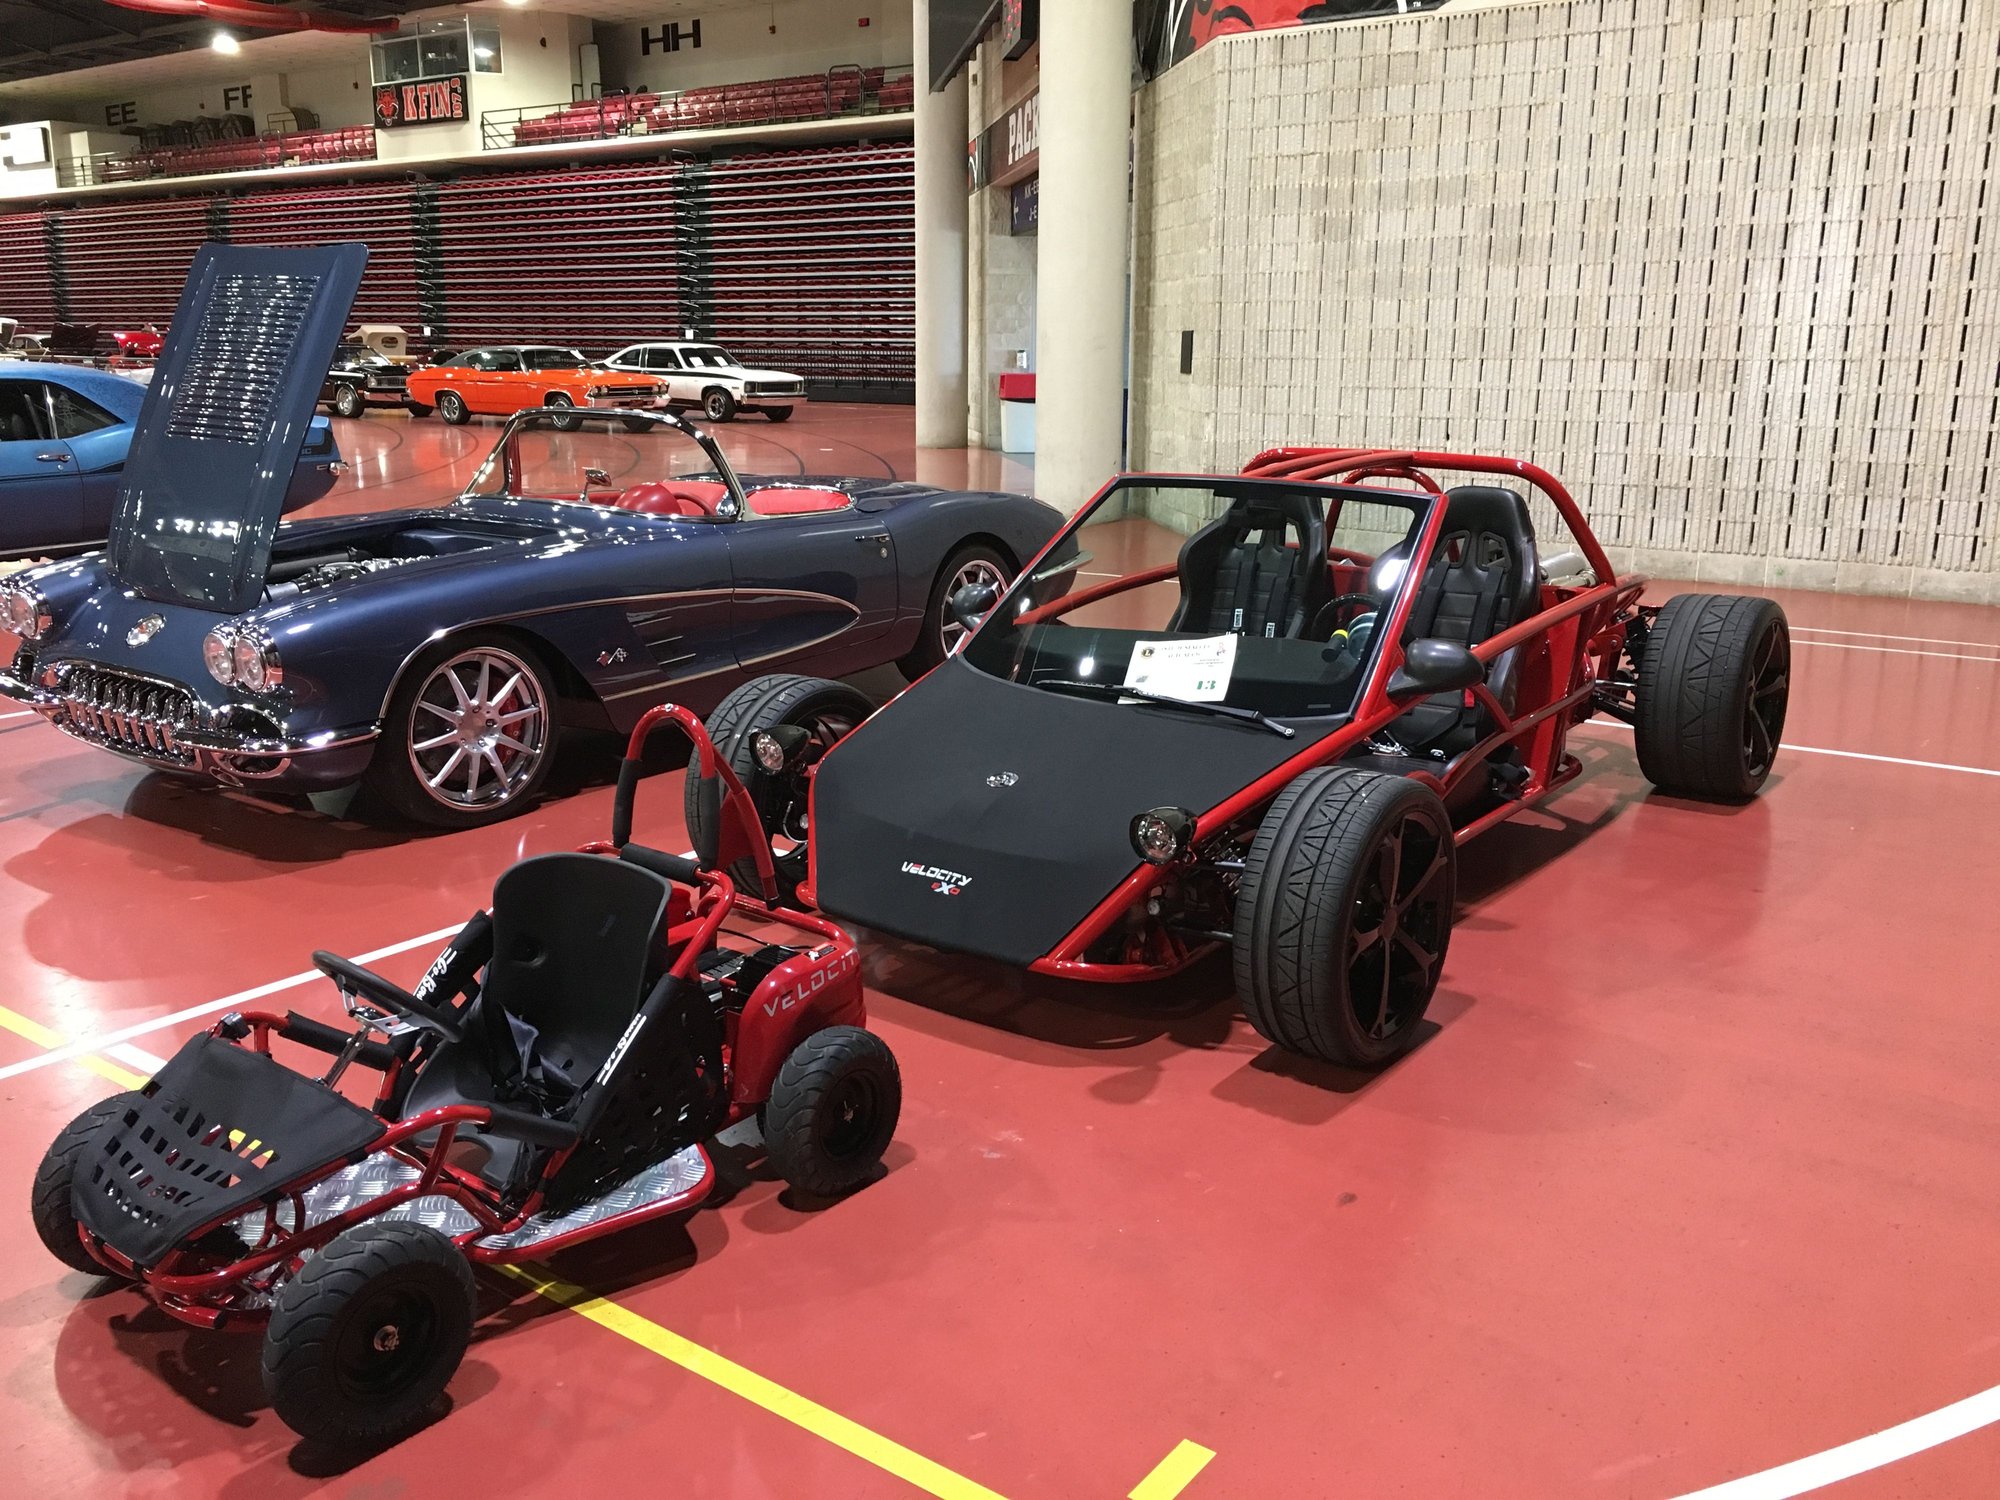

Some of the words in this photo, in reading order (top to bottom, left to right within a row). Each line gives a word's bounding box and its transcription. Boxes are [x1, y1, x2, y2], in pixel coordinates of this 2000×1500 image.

[641, 18, 701, 56] HH
[105, 101, 138, 126] EE
[402, 80, 451, 121] KFIN
[450, 77, 463, 118] 107.9
[901, 861, 973, 887] VELOCITY
[763, 947, 859, 1018] VELOCIT
